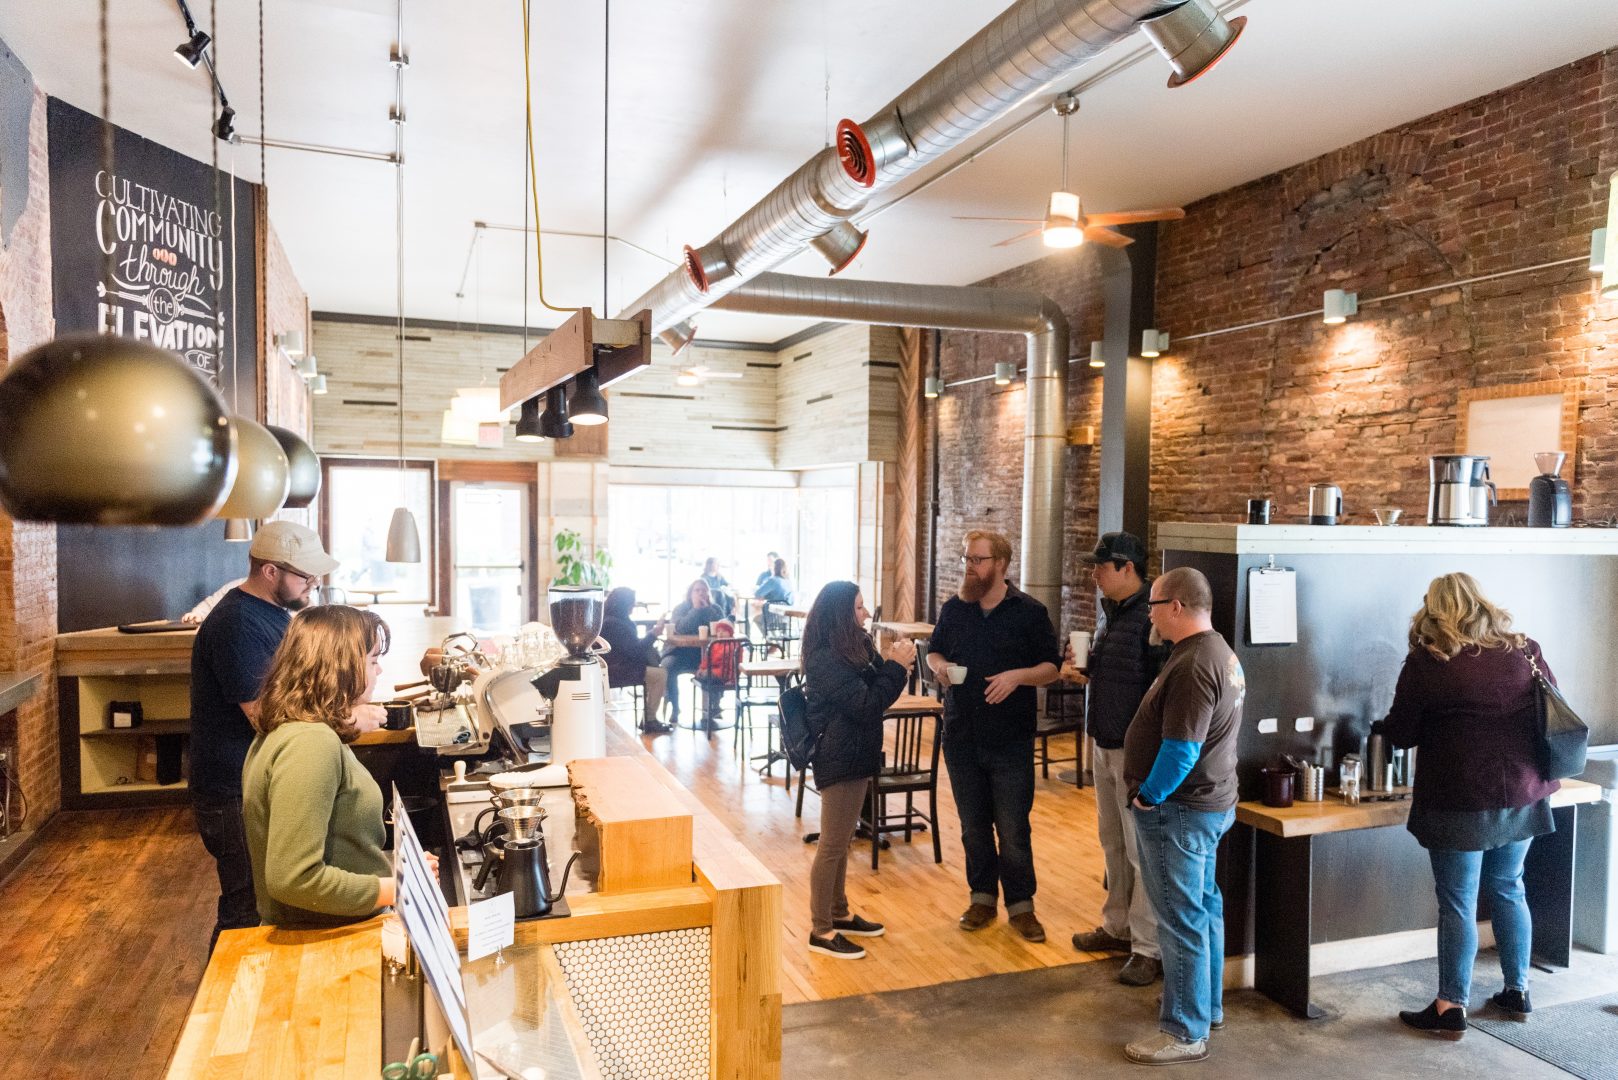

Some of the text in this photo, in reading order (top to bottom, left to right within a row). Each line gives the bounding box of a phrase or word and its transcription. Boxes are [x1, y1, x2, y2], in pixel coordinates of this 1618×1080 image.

[95, 170, 222, 237] CULTIVATING
[96, 199, 224, 291] COMMUNITY
[119, 244, 205, 300] through
[153, 296, 173, 316] the
[197, 353, 211, 369] OF
